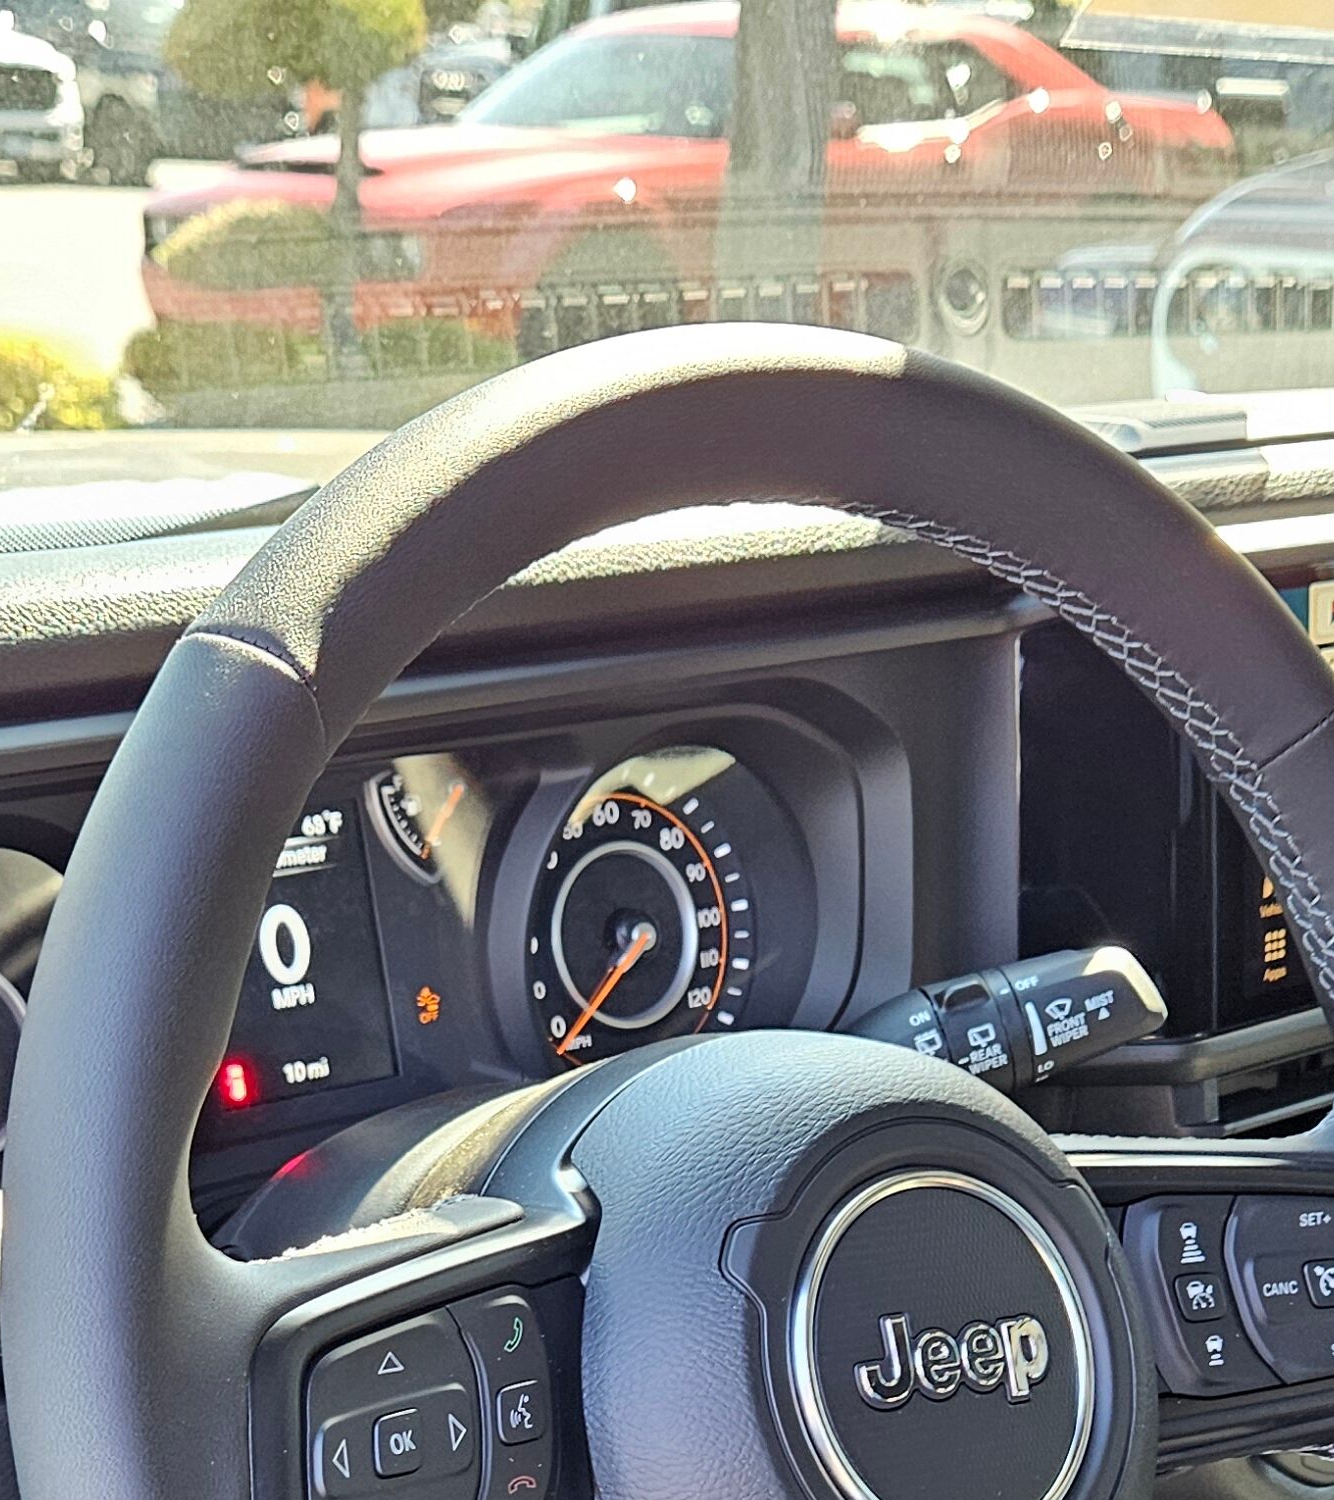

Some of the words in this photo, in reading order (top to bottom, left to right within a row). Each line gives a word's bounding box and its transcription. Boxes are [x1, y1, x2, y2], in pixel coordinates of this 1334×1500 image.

[593, 801, 619, 826] 60
[631, 809, 652, 829] 70
[659, 826, 685, 850] 80
[686, 863, 706, 883] 90
[697, 905, 721, 929] 100
[259, 903, 311, 986] 0
[700, 948, 719, 969] 110
[1014, 974, 1040, 993] OFF
[271, 983, 316, 1011] MPH
[687, 986, 712, 1009] 120
[1083, 989, 1115, 1013] MIST
[908, 1009, 932, 1028] ON
[1047, 1011, 1087, 1038] FRONT
[1049, 1023, 1090, 1049] WIPER
[968, 1052, 1009, 1076] WIPER
[969, 1042, 1003, 1063] REAR
[1037, 1059, 1056, 1074] LO
[1262, 1279, 1300, 1298] CANC
[854, 1312, 1049, 1408] Jeep
[389, 1429, 417, 1456] OK
